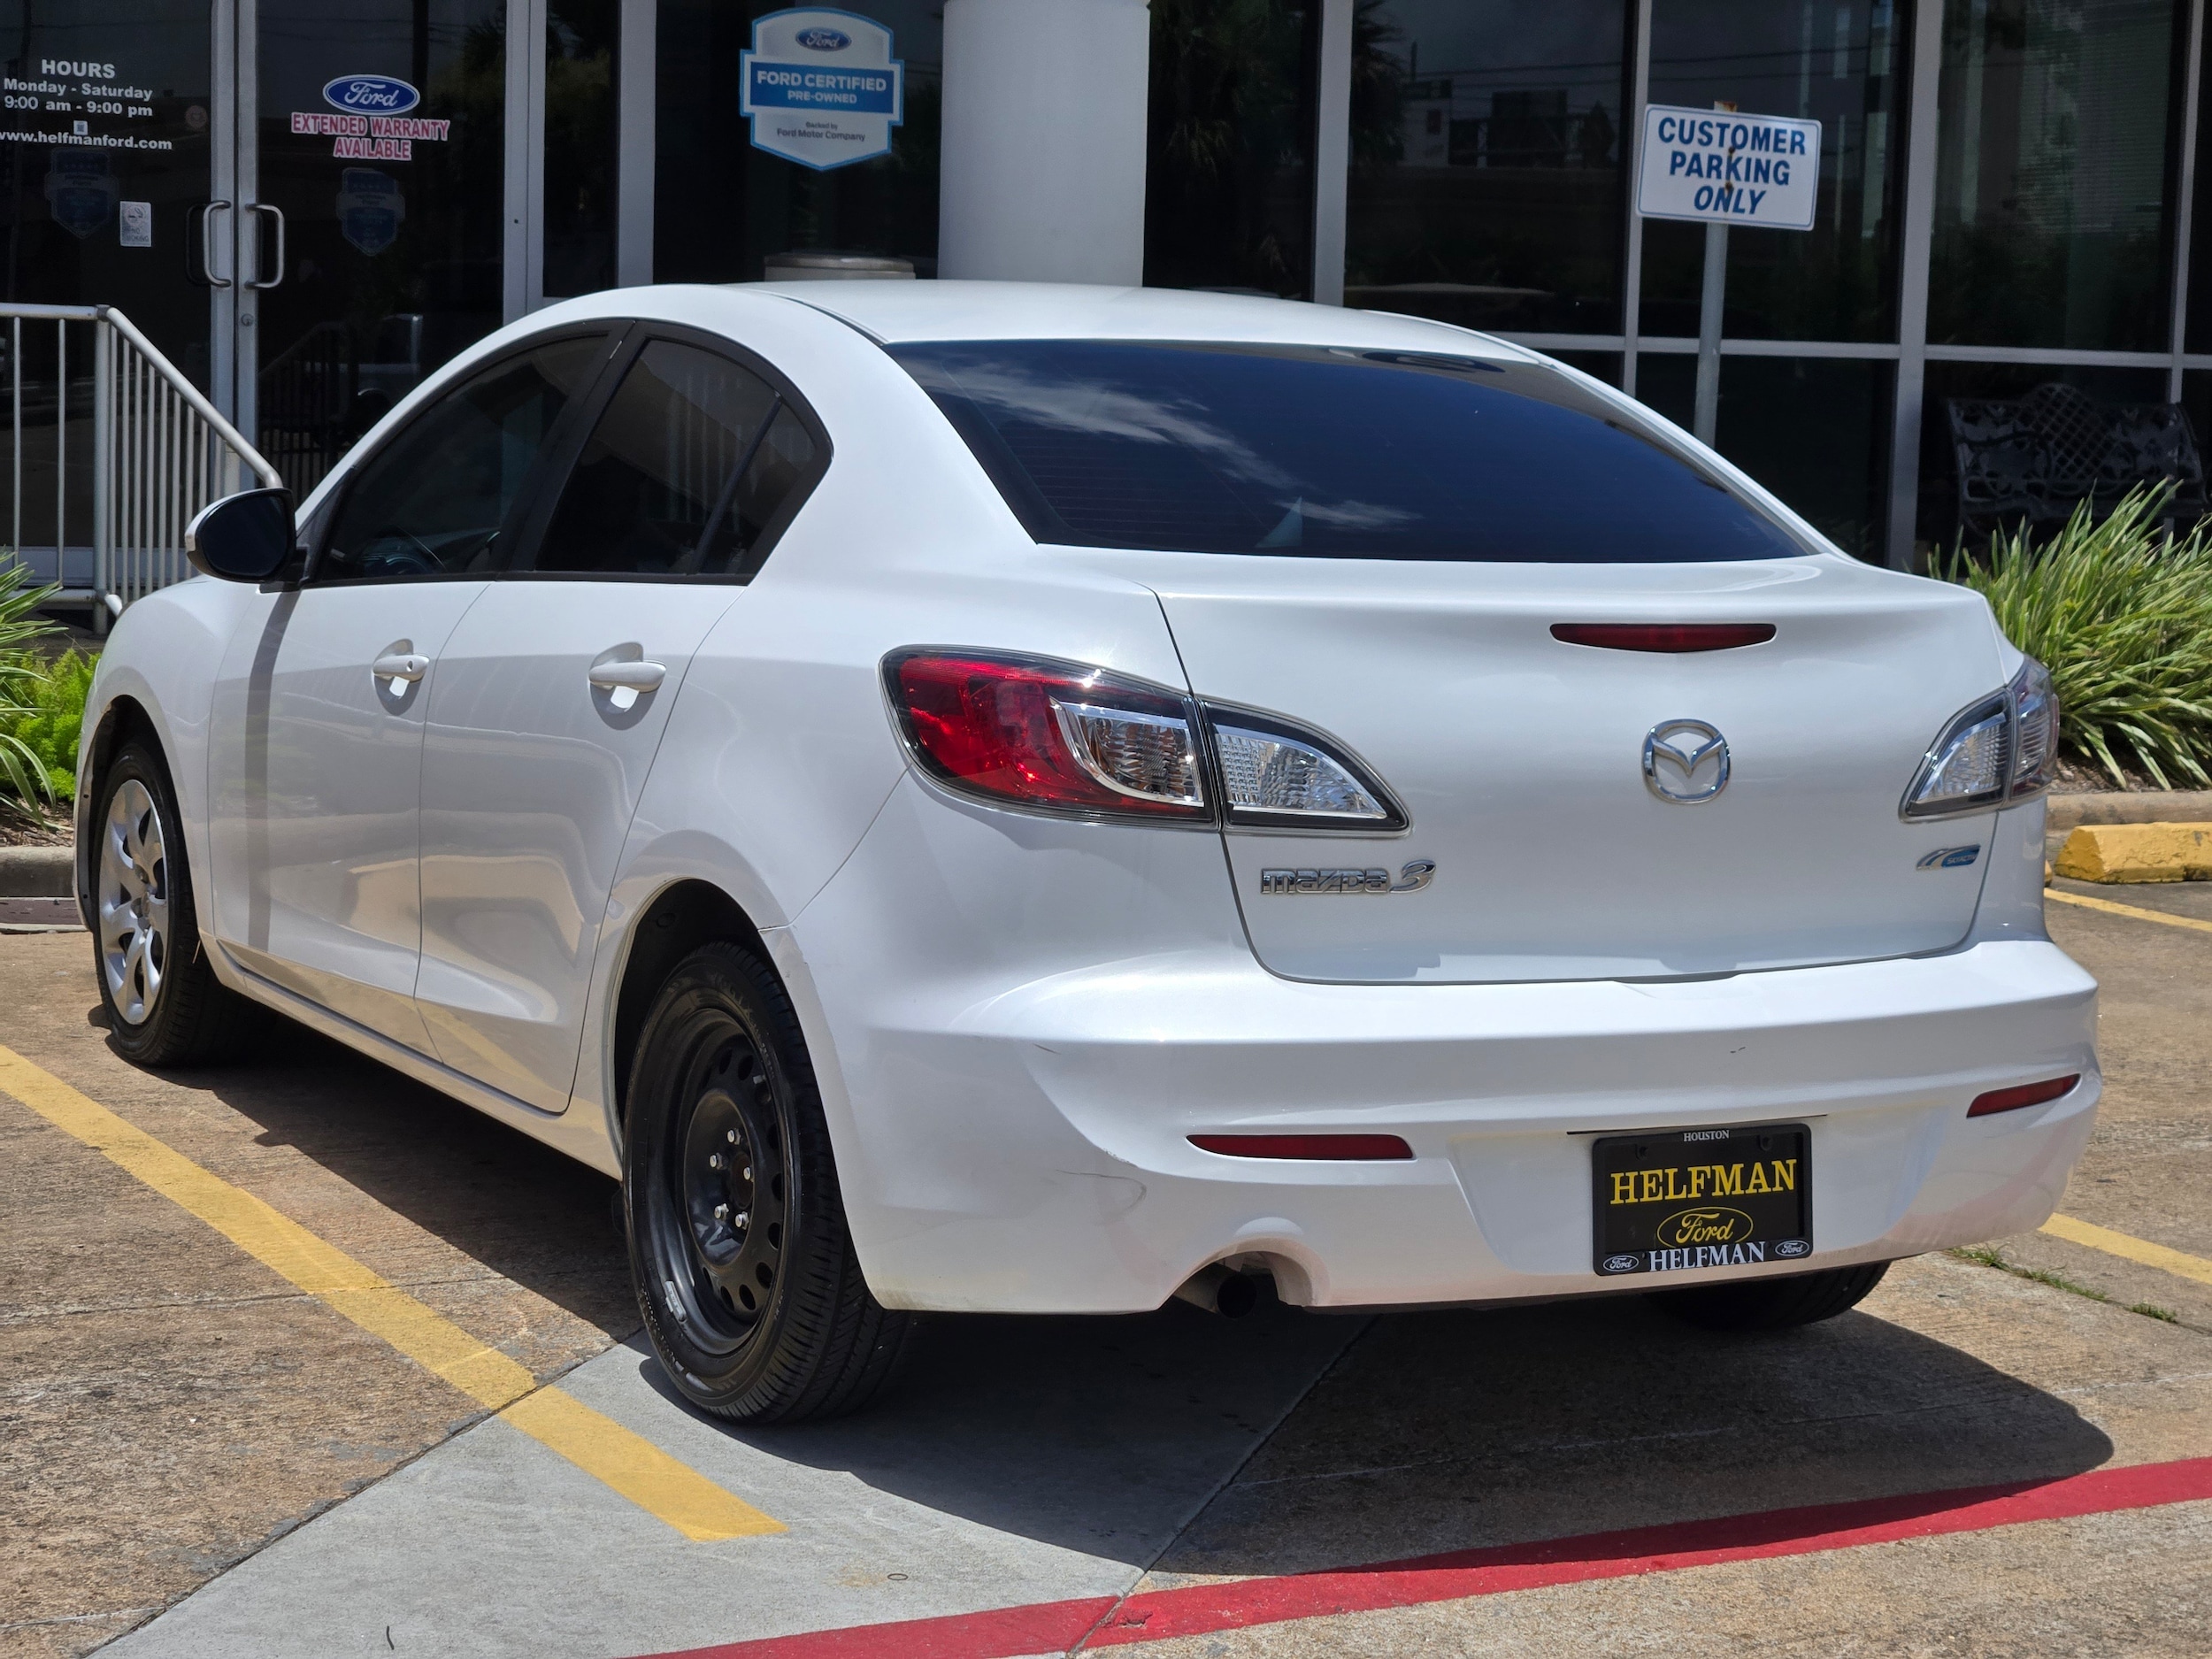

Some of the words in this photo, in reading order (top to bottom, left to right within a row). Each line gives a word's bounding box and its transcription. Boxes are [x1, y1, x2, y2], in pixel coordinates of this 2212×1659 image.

[806, 31, 841, 48] Ford
[42, 59, 116, 79] HOURS
[4, 78, 66, 96] Monday
[81, 83, 153, 102] Saturday
[757, 71, 802, 86] FORD
[804, 73, 887, 92] CERTIFIED
[343, 81, 400, 107] Ford
[787, 90, 857, 104] PRE-OWNED
[4, 95, 39, 111] 9:00
[45, 100, 72, 111] am
[86, 101, 123, 115] 9:00
[127, 105, 153, 119] pm
[293, 113, 366, 135] EXTENDED
[372, 117, 449, 140] WARRANTY
[777, 128, 797, 137] Ford
[798, 129, 824, 139] Motor
[825, 131, 865, 142] Company
[830, 122, 839, 131] by
[1658, 117, 1806, 156] CUSTOMER
[334, 138, 411, 159] AVAILABLE
[1670, 150, 1791, 186] PARKING
[1694, 185, 1766, 215] ONLY
[1683, 1130, 1730, 1142] HOUSTON
[1609, 1158, 1797, 1205] HELFMAN
[1675, 1212, 1734, 1243] Ford
[1648, 1240, 1766, 1272] HELFMAN
[1781, 1242, 1803, 1255] Ford
[1609, 1257, 1632, 1270] Ford
